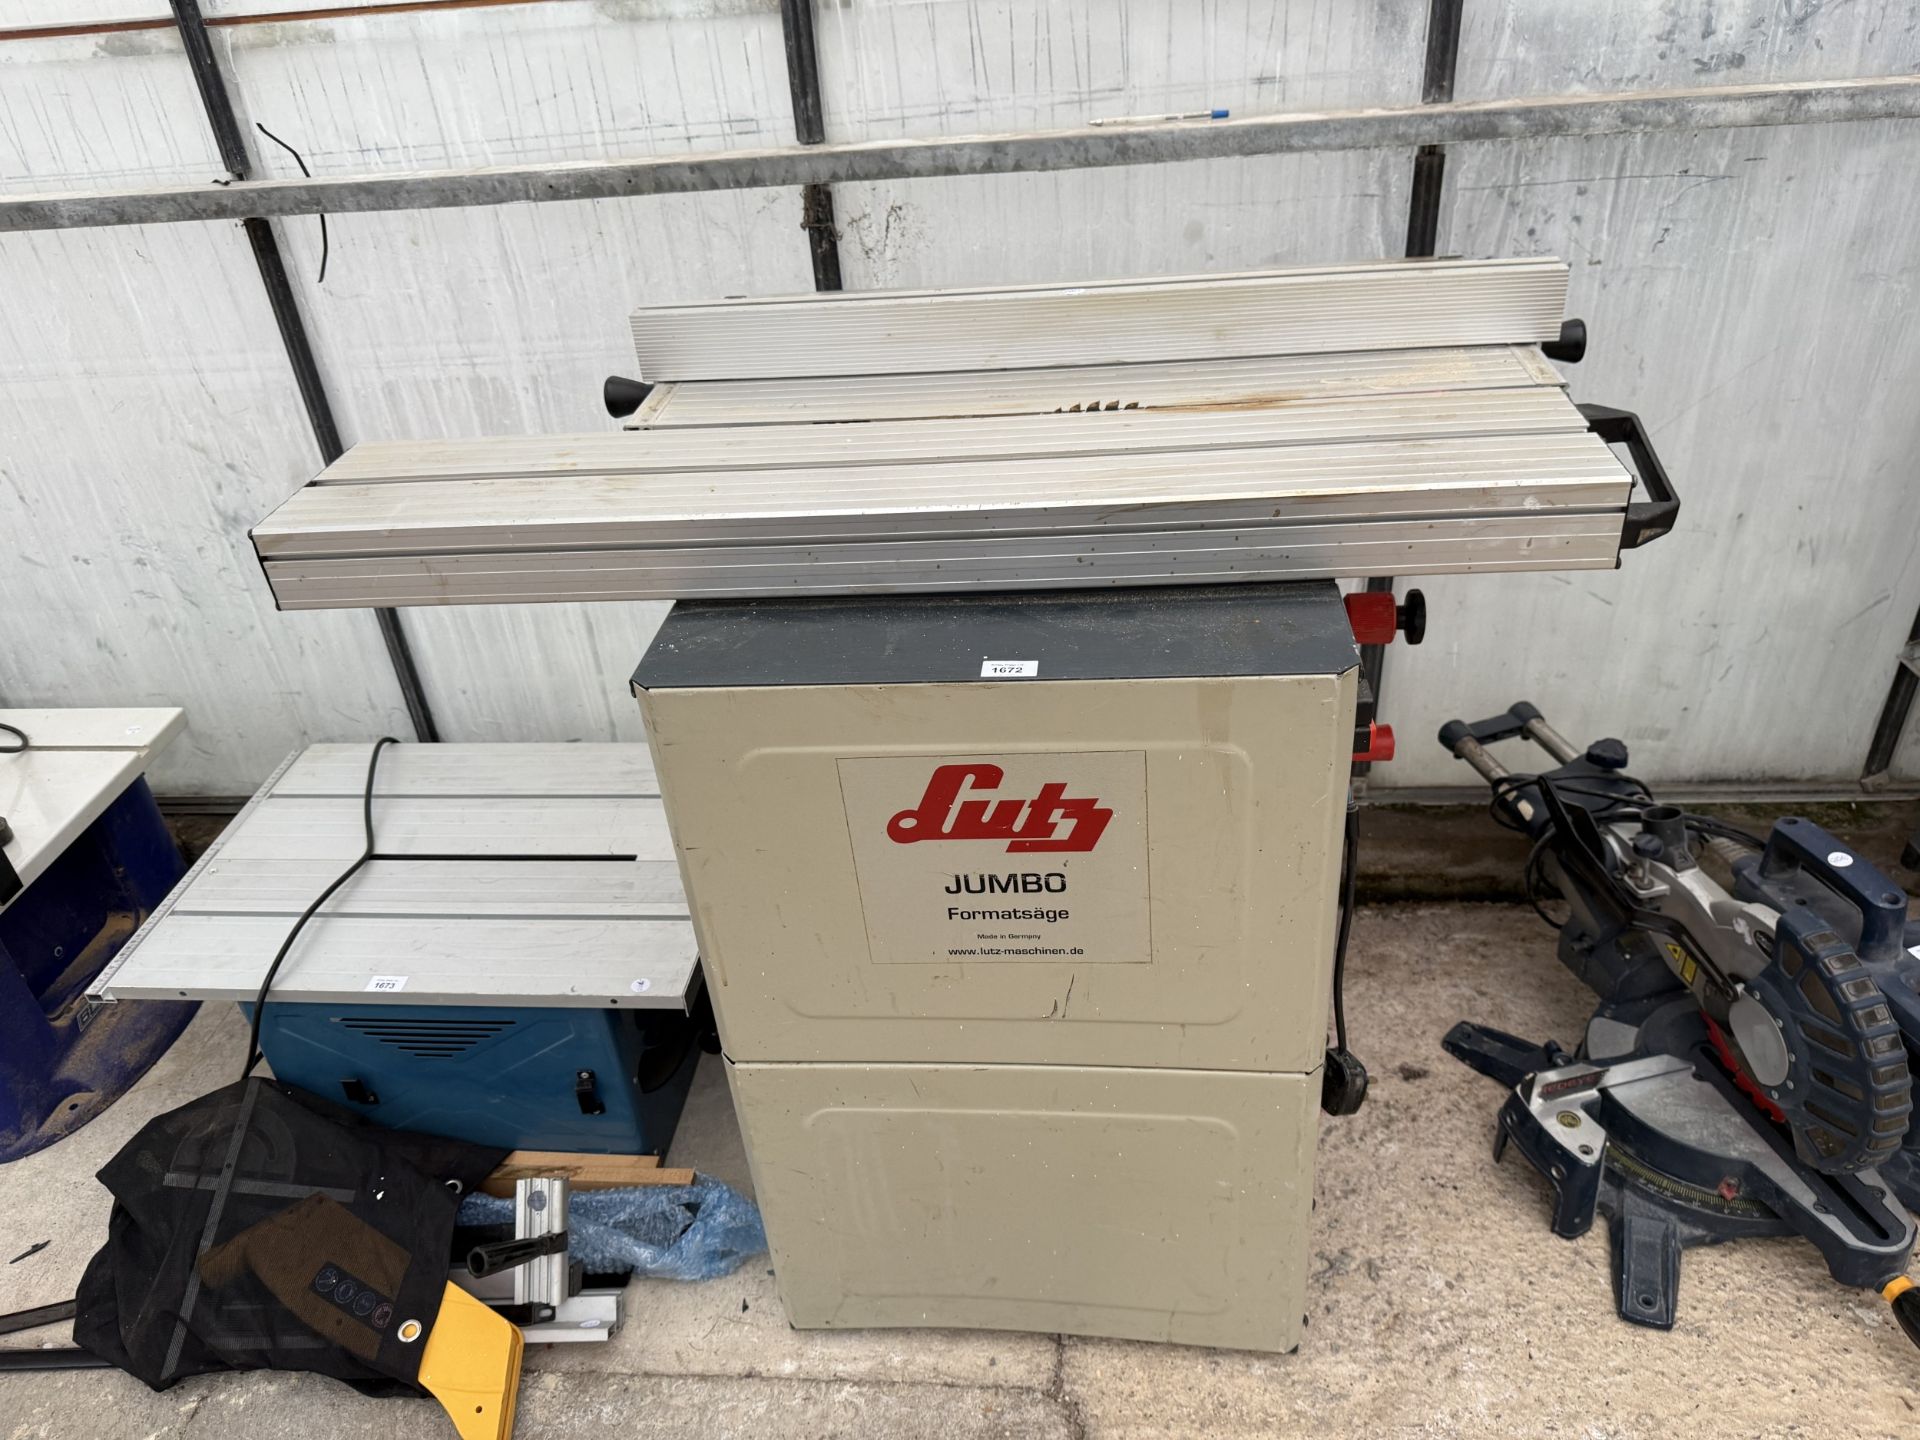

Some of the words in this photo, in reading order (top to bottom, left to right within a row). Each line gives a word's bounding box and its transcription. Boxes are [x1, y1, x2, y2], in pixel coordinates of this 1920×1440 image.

[887, 764, 1113, 853] Lutz
[945, 873, 1067, 894] JUMBO
[948, 908, 1070, 923] Formatsäge
[948, 947, 1084, 956] www.lutz-maschinen.de
